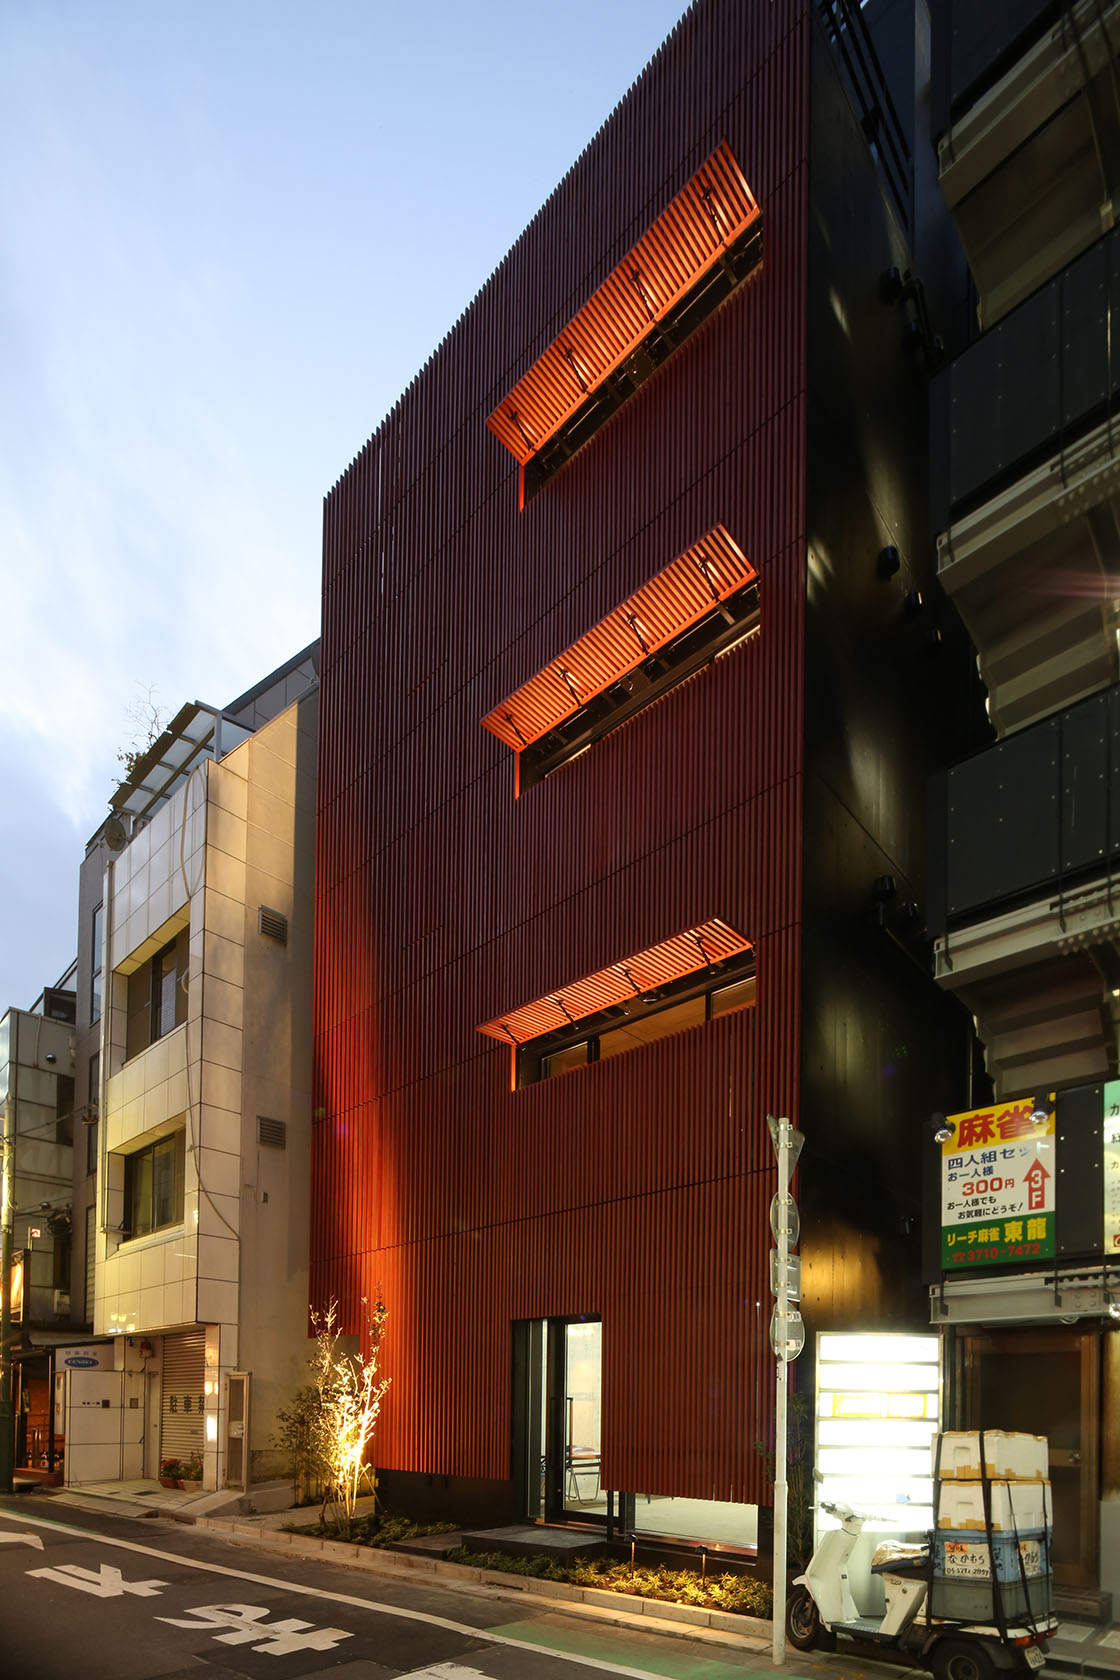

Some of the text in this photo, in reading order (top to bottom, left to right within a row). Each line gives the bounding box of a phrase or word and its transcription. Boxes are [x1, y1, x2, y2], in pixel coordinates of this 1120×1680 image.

[957, 1105, 1035, 1148] 麻雀
[948, 1141, 1050, 1170] 四人組セット
[947, 1166, 994, 1182] お一人様
[962, 1177, 1015, 1196] 300円
[1031, 1169, 1042, 1208] 3F
[947, 1196, 997, 1210] お一人様でも
[947, 1227, 1000, 1247] リーチ麻雀
[967, 1241, 1041, 1261] 3710-7472
